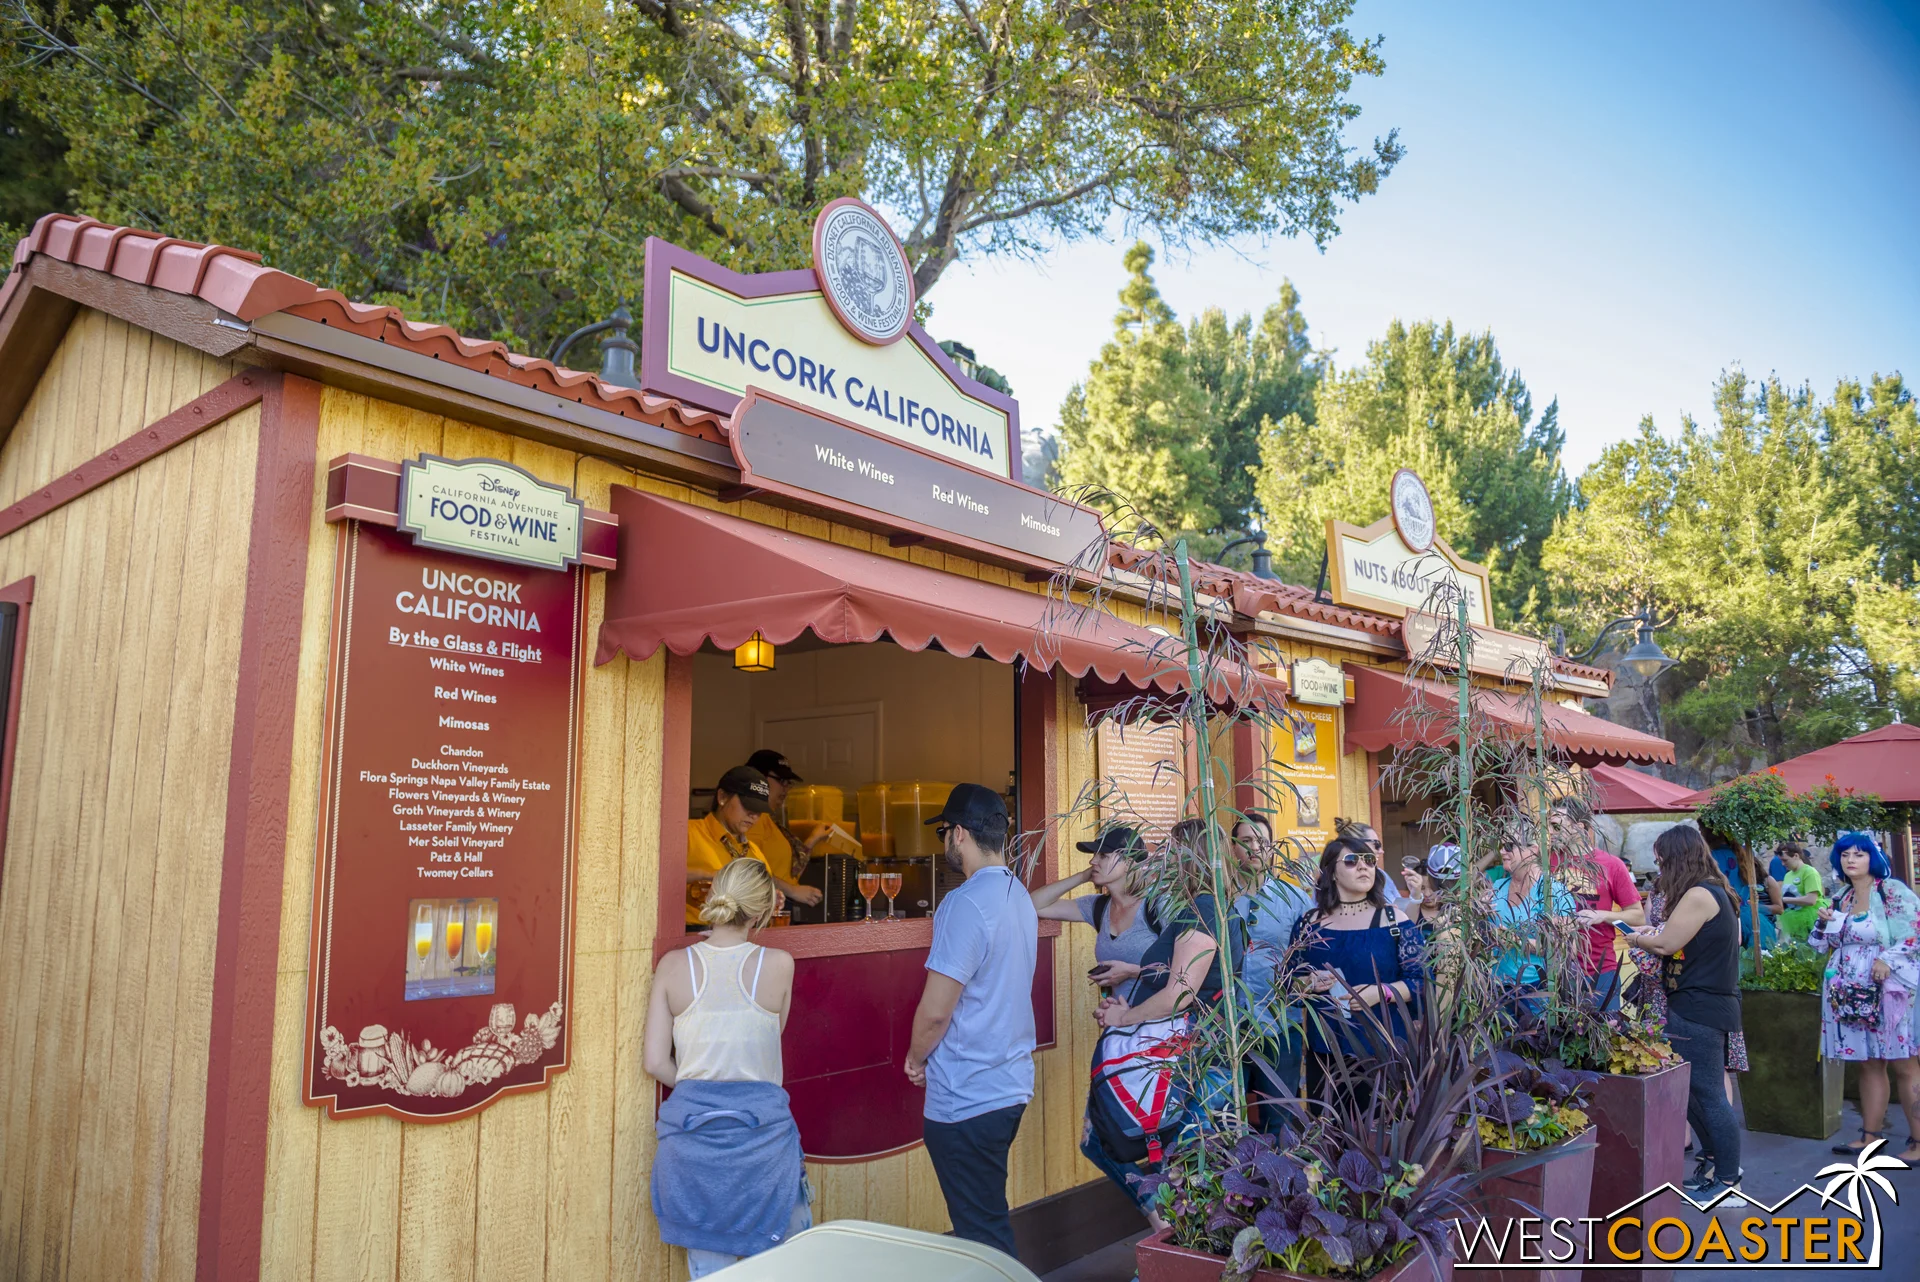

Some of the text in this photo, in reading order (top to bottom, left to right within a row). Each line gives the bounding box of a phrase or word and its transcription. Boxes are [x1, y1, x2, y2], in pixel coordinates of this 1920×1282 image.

[827, 214, 905, 296] DISNEY CALIFORNIA ADVENTURE
[833, 277, 850, 307] FOOD
[857, 311, 878, 328] WINE
[879, 306, 902, 329] FESTIVAL
[697, 316, 994, 460] UNCORK CALIFORNIA
[815, 444, 895, 485] White Wines
[432, 485, 559, 519] CALIFORNIA ADVENTURE
[932, 484, 989, 515] Red Wines
[430, 497, 558, 542] FOOD & WINE
[1021, 512, 1061, 537] Mimosas
[470, 529, 520, 547] FESTIVAL
[422, 567, 521, 604] UNCORK
[1353, 557, 1388, 584] NUTS
[1391, 570, 1430, 594] ABOUT
[396, 591, 541, 633] CALIFORNIA
[389, 626, 542, 663] By the Glass & Flight
[430, 657, 505, 677] White Wines
[434, 686, 497, 704] Red Wines
[1301, 679, 1318, 691] FOOD
[1323, 682, 1338, 694] WINE
[439, 715, 490, 731] Mimosas
[1311, 711, 1333, 722] CHEESE
[440, 745, 483, 758] Chandon
[412, 758, 509, 775] Duckhorn Vineyards
[360, 771, 551, 791] Flora Springs Napa Valley Family Estate
[389, 788, 526, 806] Flowers Vineyards & Winery
[393, 804, 521, 820] Groth Vineyards & Winery
[400, 820, 513, 835] Lasseter Family Winery
[408, 836, 504, 849] Mer Soleil Vineyard
[430, 852, 482, 863] Patz & Hall
[417, 866, 493, 880] Twomey Cellars
